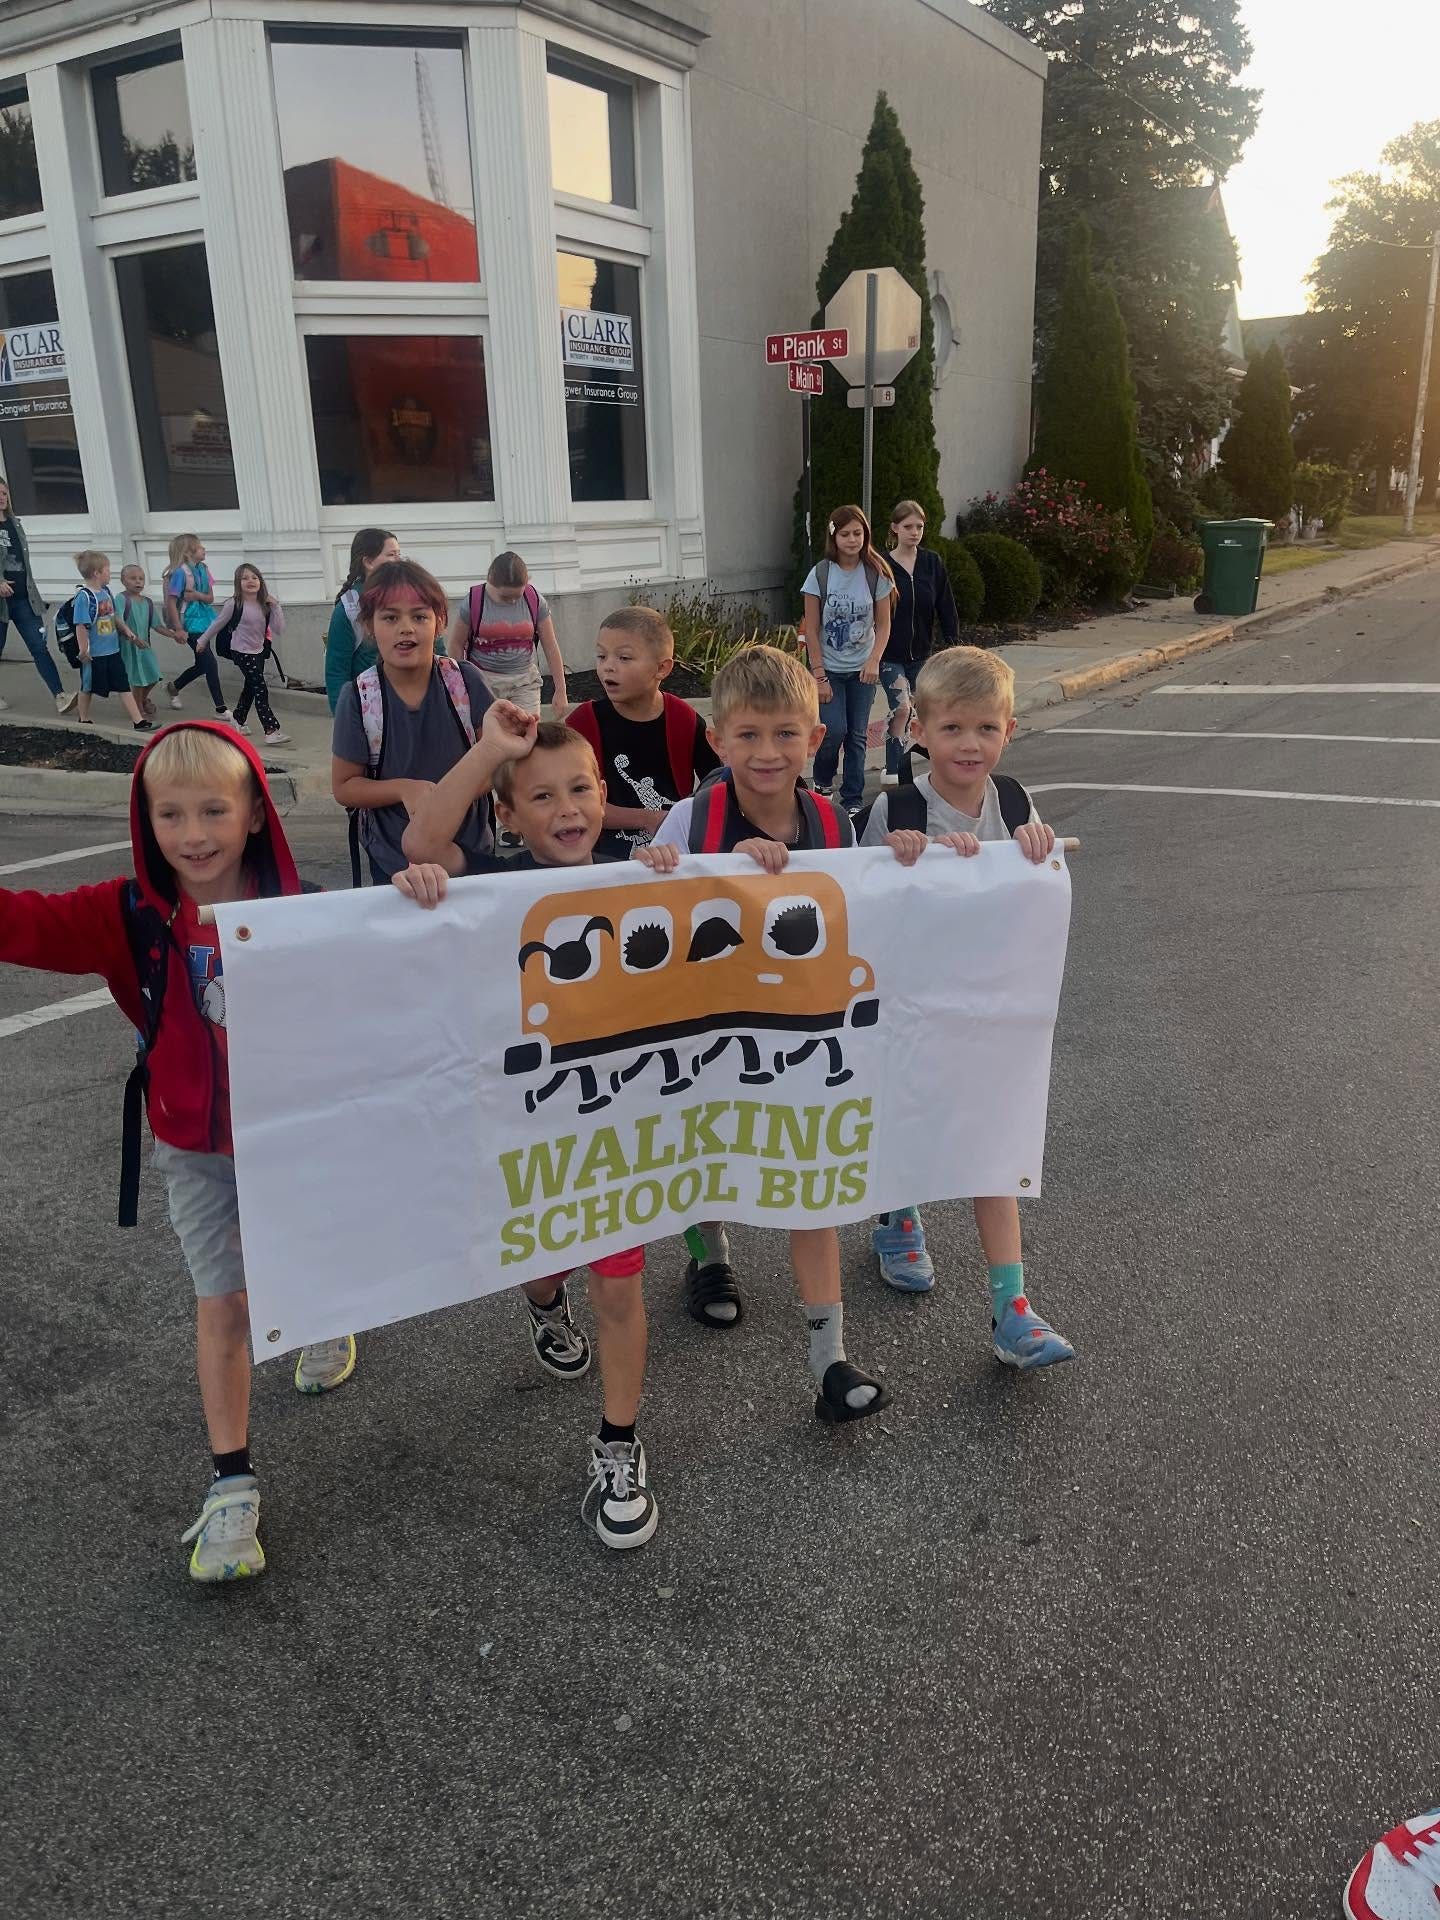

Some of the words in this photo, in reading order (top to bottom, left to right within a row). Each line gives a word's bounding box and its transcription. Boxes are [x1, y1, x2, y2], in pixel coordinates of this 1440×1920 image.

[568, 314, 631, 345] CLARK
[10, 329, 64, 357] CLAR
[570, 341, 607, 354] INSURANCE
[609, 346, 631, 357] GROUP
[771, 343, 778, 355] N
[783, 334, 826, 359] Plank
[832, 337, 843, 350] St
[15, 357, 54, 369] INSURANCE
[796, 365, 814, 390] Main
[565, 386, 582, 397] gwer
[584, 384, 615, 398] Insurance
[617, 387, 638, 403] Group
[0, 402, 31, 417] Gangwer
[33, 400, 67, 412] Insurance
[499, 1097, 873, 1208] WALKING
[500, 1162, 738, 1266] SCHOOL
[756, 1160, 868, 1210] BUS
